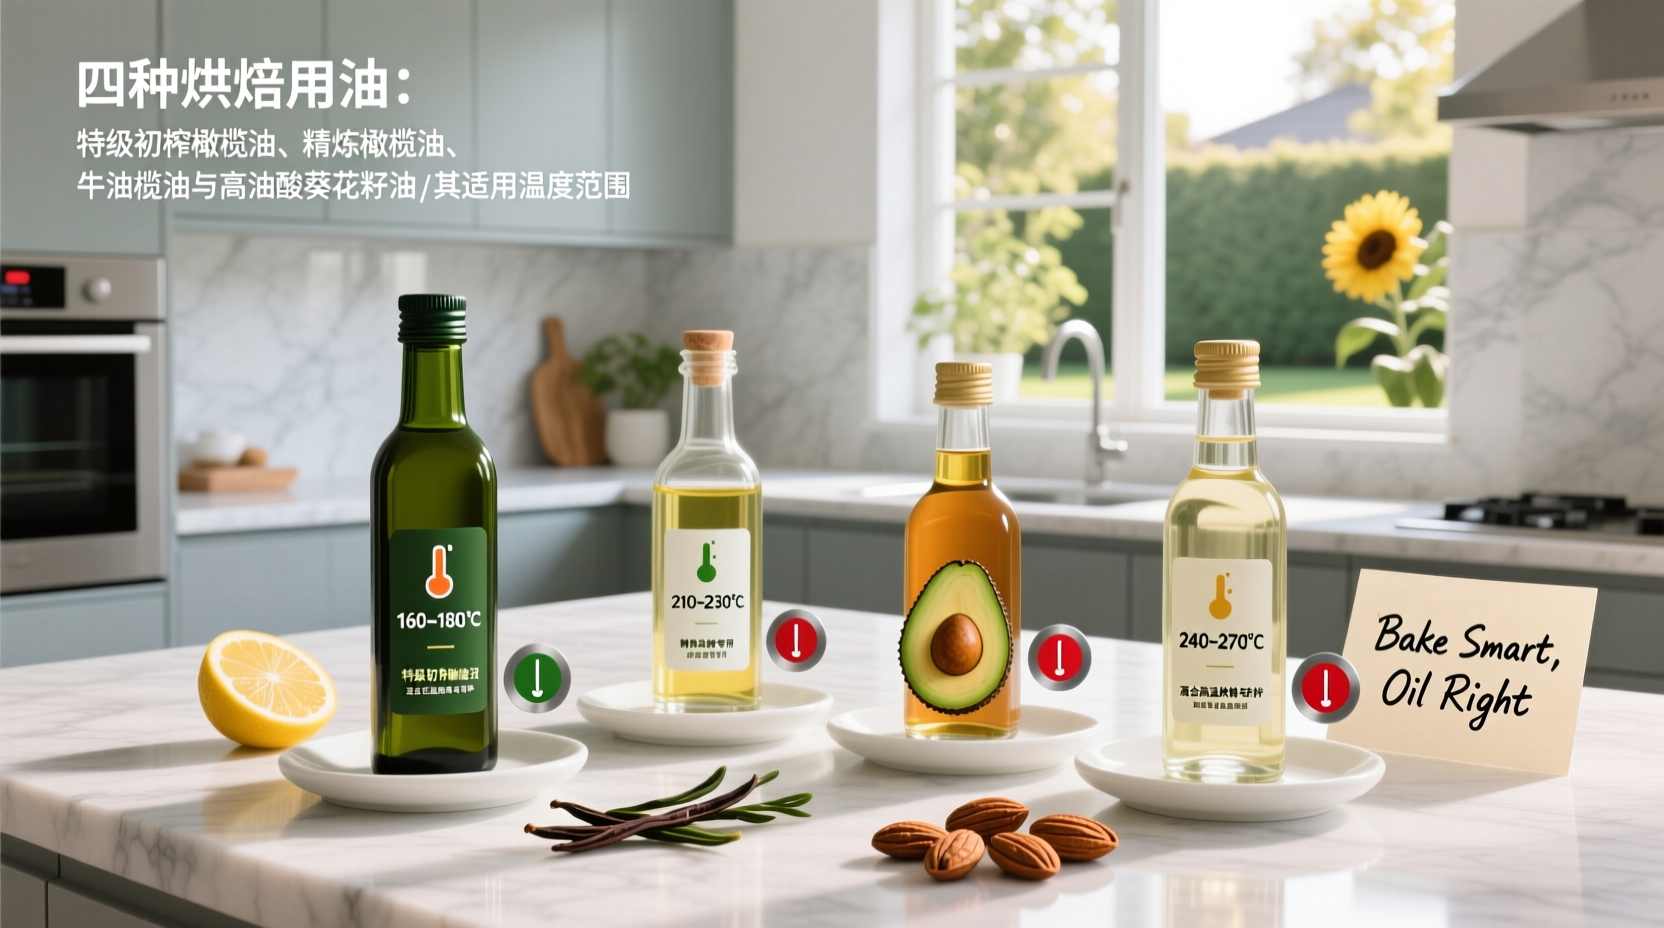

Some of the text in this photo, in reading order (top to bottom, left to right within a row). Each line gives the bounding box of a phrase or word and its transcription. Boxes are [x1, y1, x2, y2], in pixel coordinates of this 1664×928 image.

[1374, 613, 1561, 673] Bake Smart,
[1381, 668, 1533, 732] Oil Right
